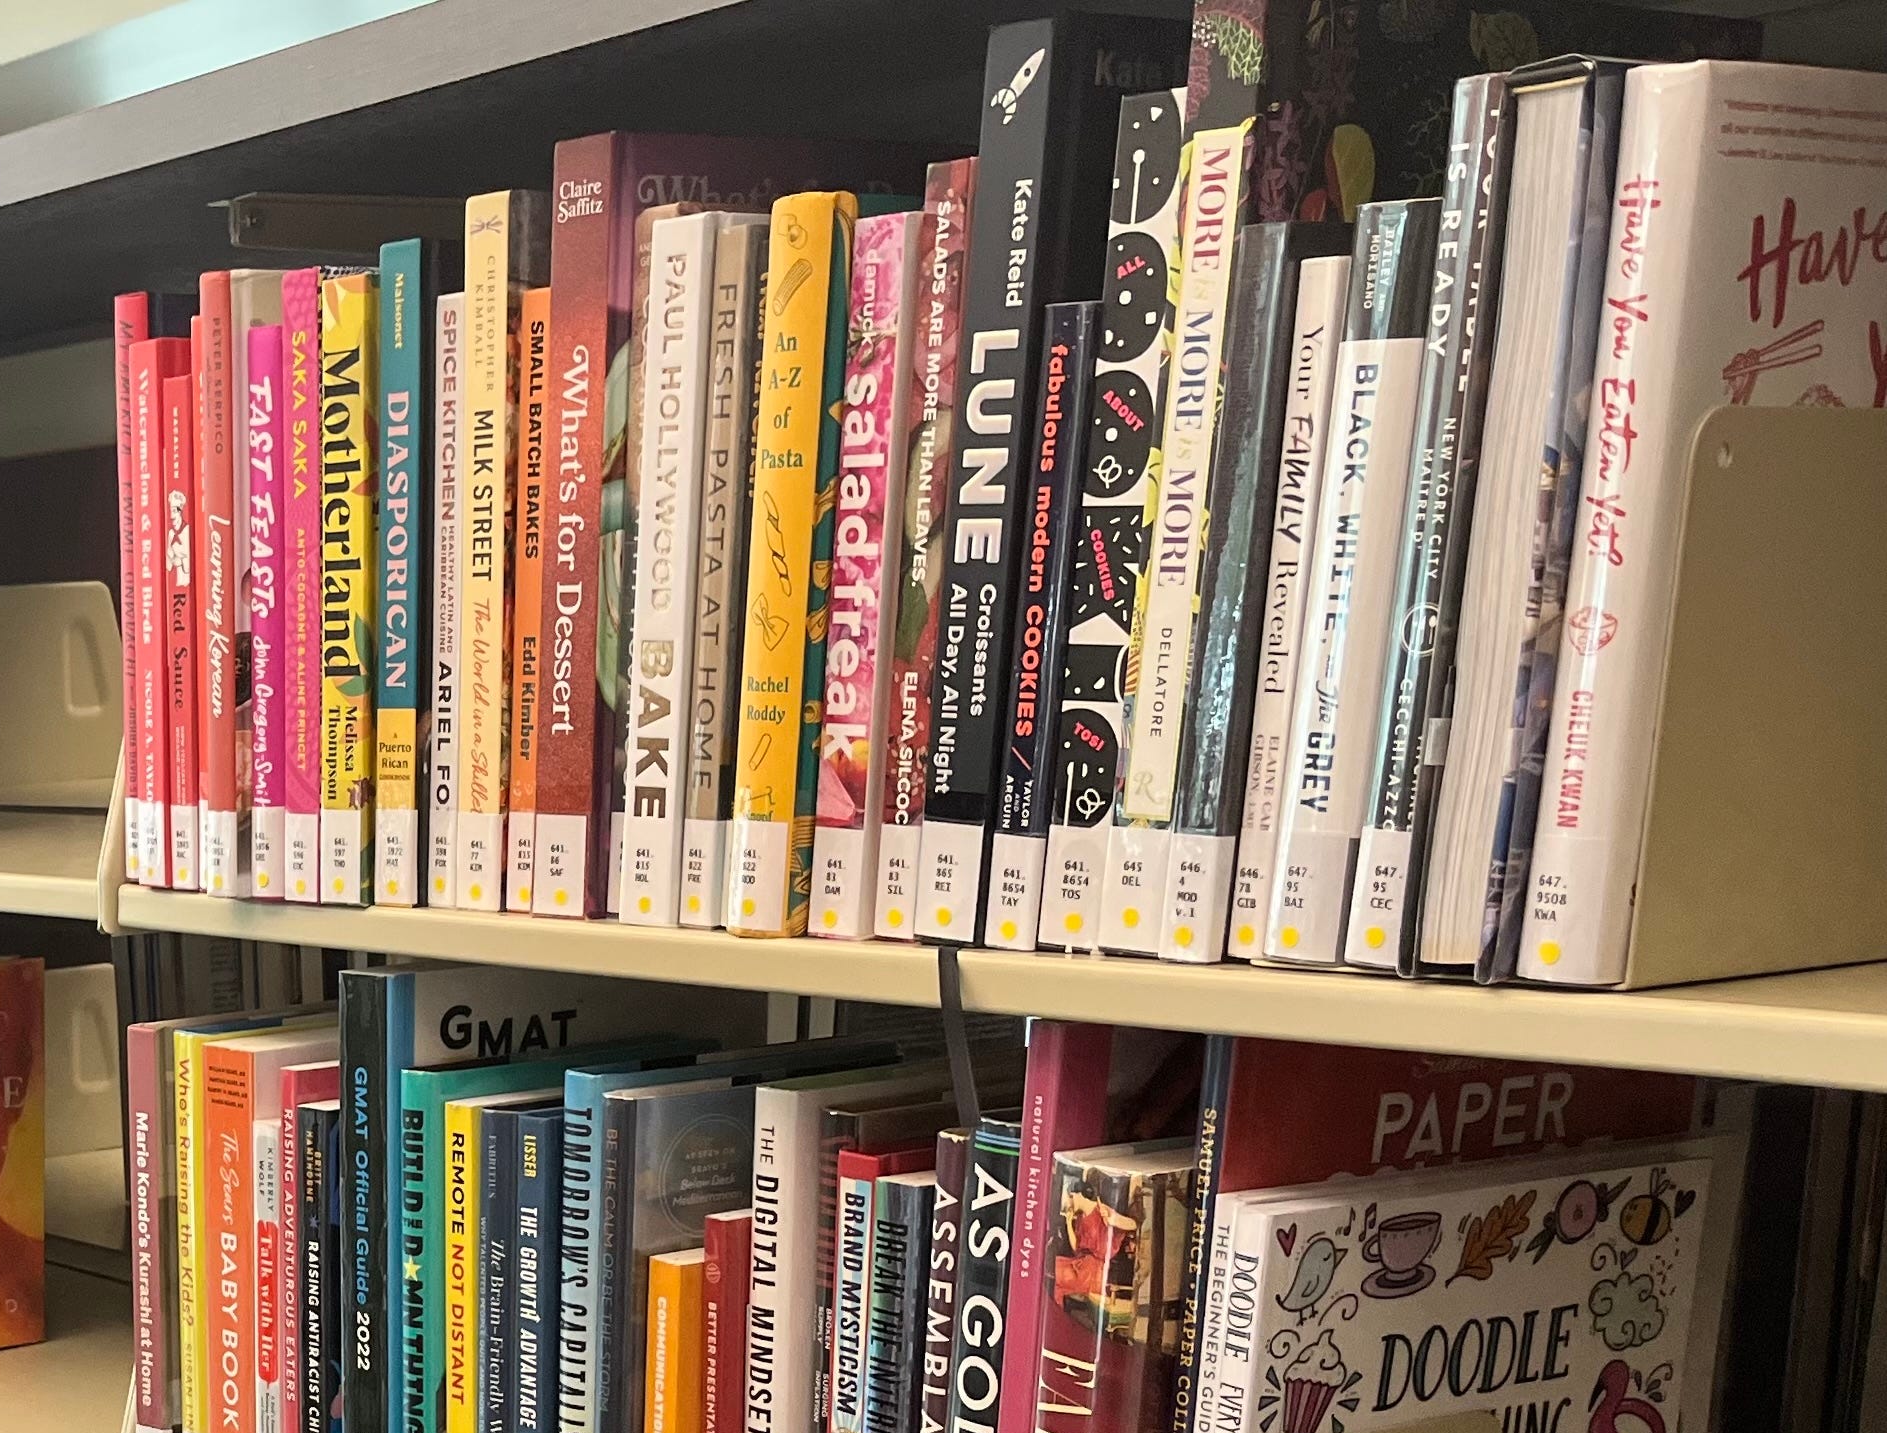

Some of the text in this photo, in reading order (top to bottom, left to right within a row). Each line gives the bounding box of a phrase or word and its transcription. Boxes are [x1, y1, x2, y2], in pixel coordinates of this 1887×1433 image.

[557, 198, 603, 223] Saffitz
[559, 179, 602, 199] Claire
[1618, 174, 1661, 279] Have
[1004, 179, 1033, 309] Kate Reid
[1116, 255, 1146, 280] ALL
[1428, 210, 1464, 357] READY
[769, 368, 801, 388] A-Z
[775, 333, 797, 354] An
[1158, 148, 1232, 588] MORE MORE MORE
[1607, 293, 1649, 360] You
[292, 331, 307, 498] SAKA SAKA
[441, 311, 457, 520] SPICE KITCHEN
[524, 320, 545, 559] SMALL BATCH BAKES
[652, 255, 685, 612] PAUL HOLLYWOOD
[774, 407, 791, 429] of
[910, 199, 952, 588] SALADS ARE MORE THAN LEAVES.
[954, 330, 1019, 563] LUNE
[1102, 389, 1145, 432] ABOUT
[1599, 377, 1639, 488] Eaten
[249, 377, 275, 618] FAST FEASTS
[321, 346, 362, 678] Motherland
[472, 409, 493, 582] MILK STREET
[760, 451, 804, 469] Pasta
[385, 392, 410, 688] DIASPORICAN
[550, 345, 589, 734] What's for Dessert
[692, 284, 738, 790] FRESH PASTA AT HOME
[1014, 344, 1070, 738] fabulous modern COOKIES
[1090, 529, 1116, 601] COOKIES
[970, 583, 997, 716] Croissants
[1263, 560, 1300, 695] Revealed
[520, 636, 536, 760] Edd Kimber
[633, 640, 675, 819] BAKE
[746, 676, 790, 694] Rachel
[746, 706, 785, 725] Roddy
[933, 584, 968, 795] All Day, All Night
[1074, 721, 1105, 752] TOSI
[1149, 628, 1172, 739] DELLATORE
[327, 705, 341, 800] Thompson
[344, 705, 355, 772] Melissa
[378, 741, 412, 757] Puerto
[381, 757, 409, 769] Rican
[1300, 731, 1337, 814] GREY
[1557, 690, 1594, 828] CHEUK KWAN
[1121, 875, 1141, 887] DEL
[1123, 861, 1142, 873] 645
[1535, 909, 1557, 921] KWA
[1536, 892, 1567, 905] 9508
[440, 1006, 577, 1058] GMAT
[134, 1111, 149, 1169] Marie
[759, 1126, 775, 1164] THE
[1372, 1073, 1575, 1164] PAPER
[136, 1172, 150, 1249] Kondo's
[353, 1065, 371, 1370] GMAT Official Guide 2022
[750, 1174, 779, 1296] DIGITAL
[967, 1163, 1014, 1263] AS
[1020, 1095, 1043, 1279] natural kitchen dyes
[451, 1133, 466, 1405] REMOTE NOT DISTANT
[836, 1192, 866, 1416] BRAND MYSTICISM
[139, 1329, 153, 1350] at
[140, 1352, 154, 1407] Home
[220, 1234, 241, 1431] BABY BOOK
[1372, 1304, 1578, 1413] DOODLE
